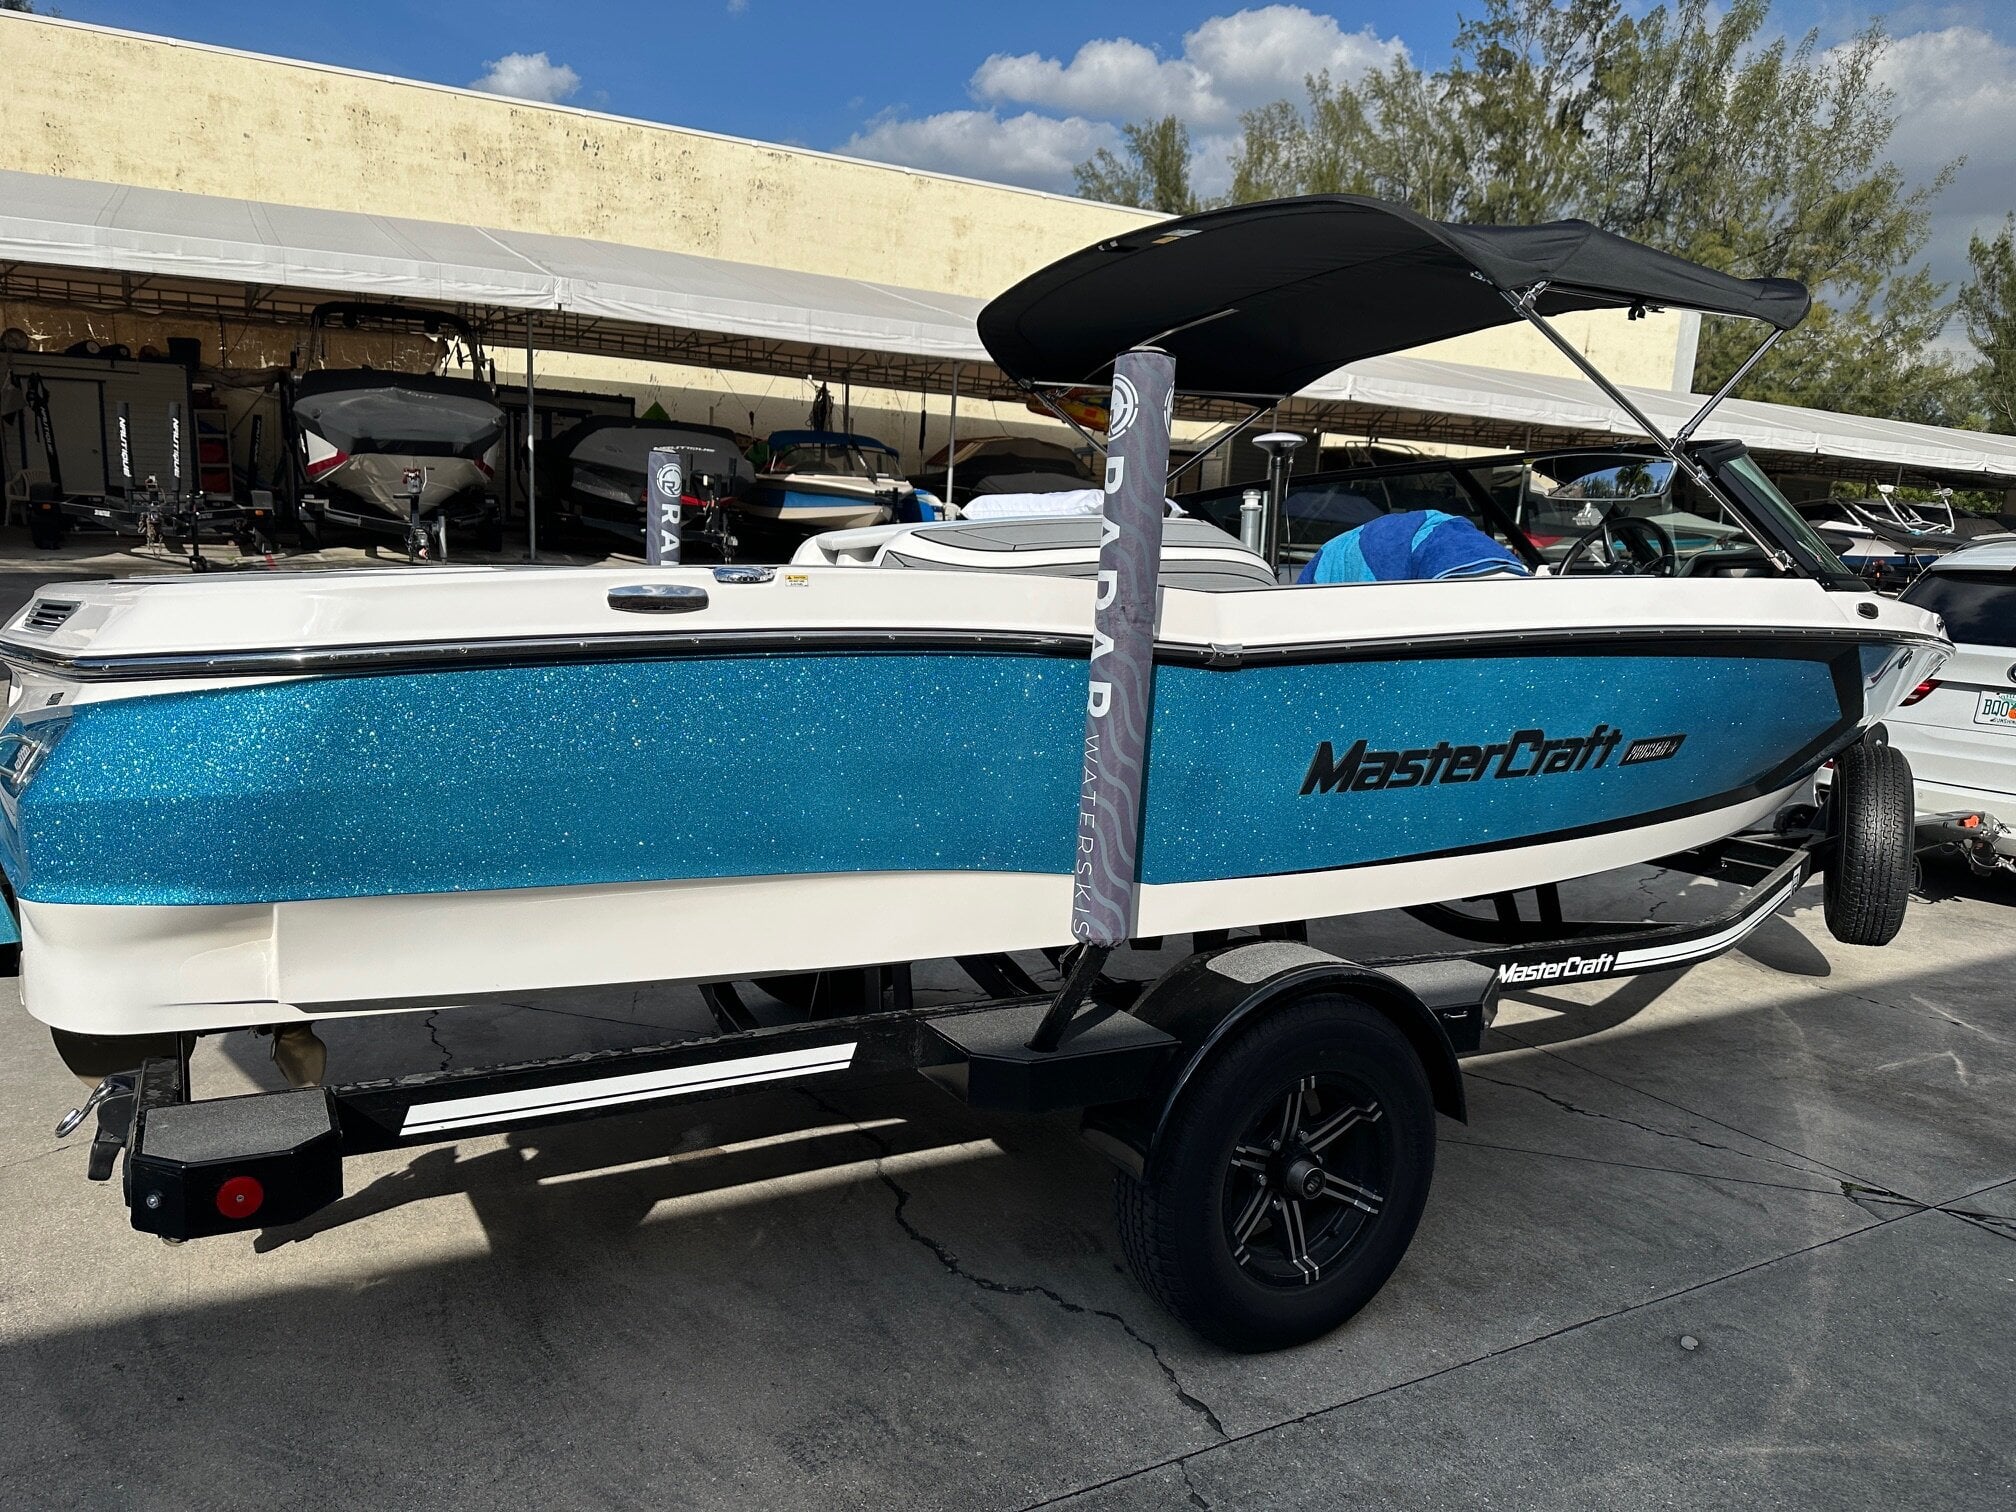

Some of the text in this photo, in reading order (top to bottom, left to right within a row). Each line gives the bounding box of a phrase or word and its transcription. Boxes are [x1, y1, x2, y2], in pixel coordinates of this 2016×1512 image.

[118, 416, 132, 478] NAUTIQUE
[172, 417, 181, 478] NAUTIQUE
[661, 503, 680, 566] RA
[1300, 724, 1624, 796] MasterCraft
[1625, 741, 1671, 762] PROSTAR
[1073, 734, 1100, 937] WATERSKIS
[1499, 952, 1614, 984] MasterCraft
